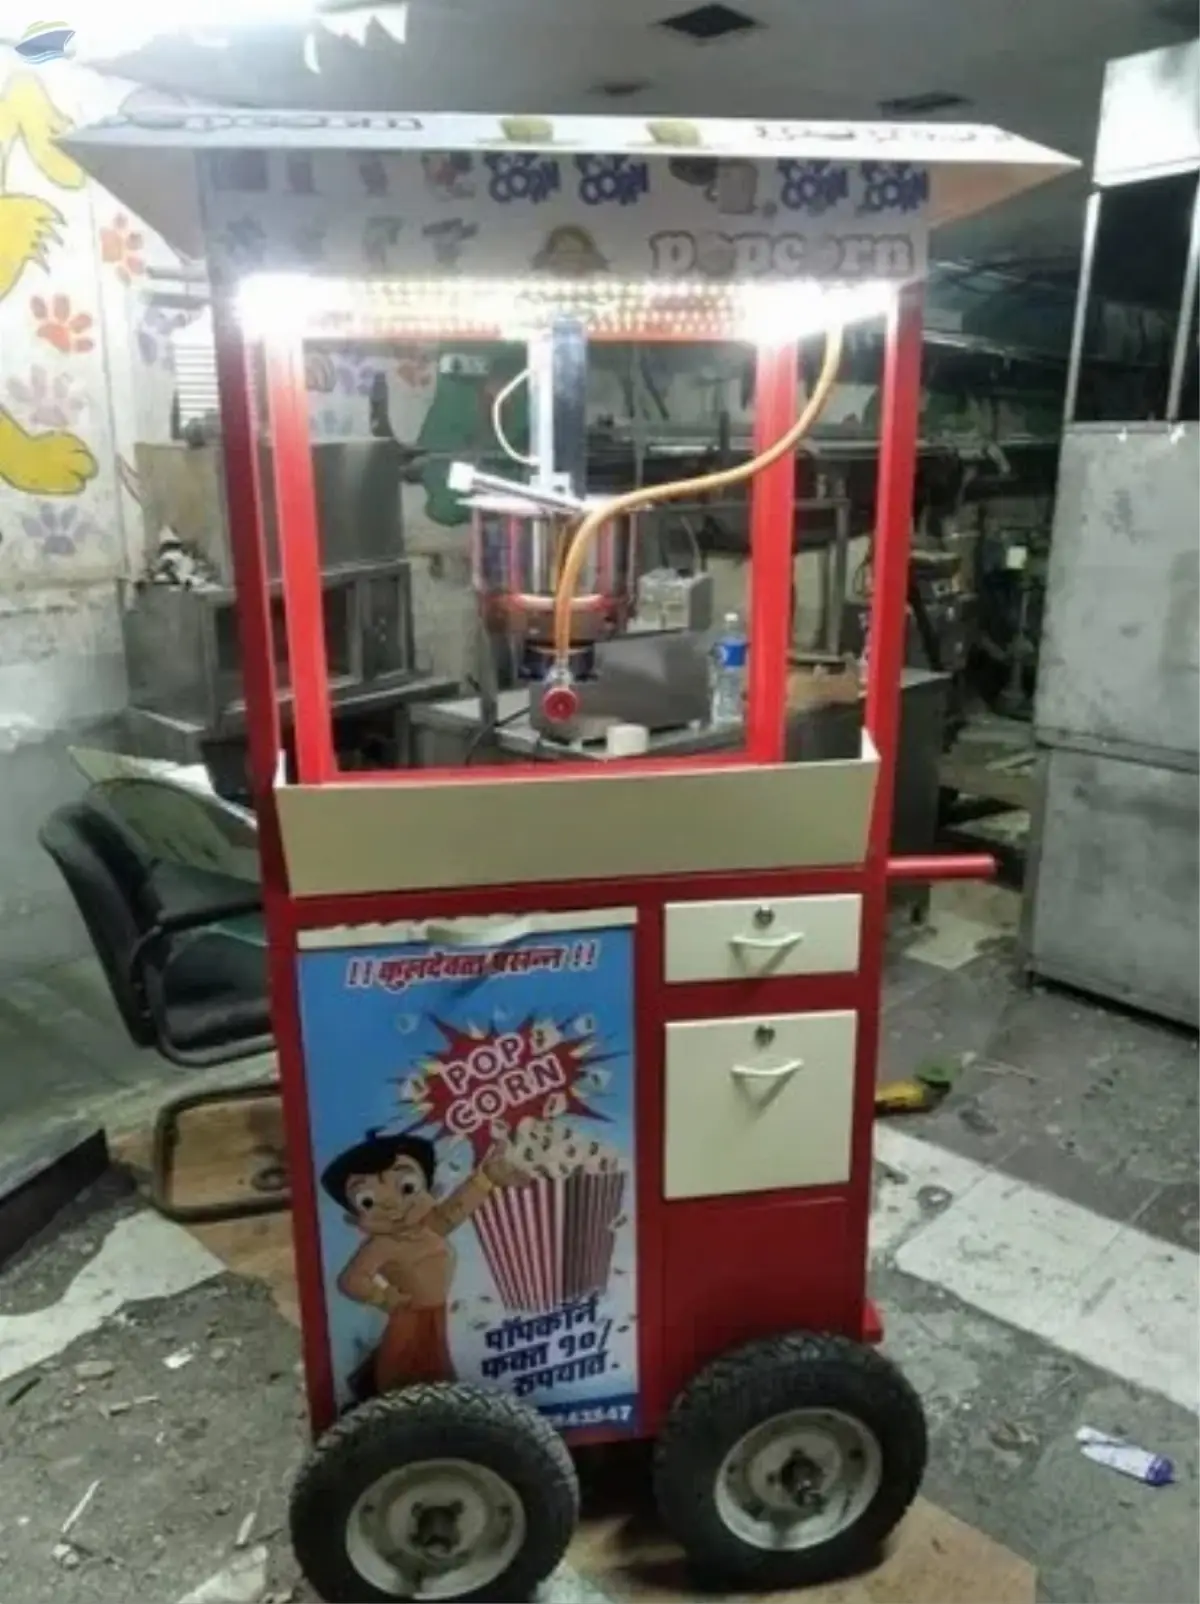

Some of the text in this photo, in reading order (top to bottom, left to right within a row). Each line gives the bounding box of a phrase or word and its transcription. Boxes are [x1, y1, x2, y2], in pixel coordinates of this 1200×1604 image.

[440, 1032, 524, 1094] POP
[445, 1053, 566, 1134] CORN
[481, 1342, 549, 1379] फक्त
